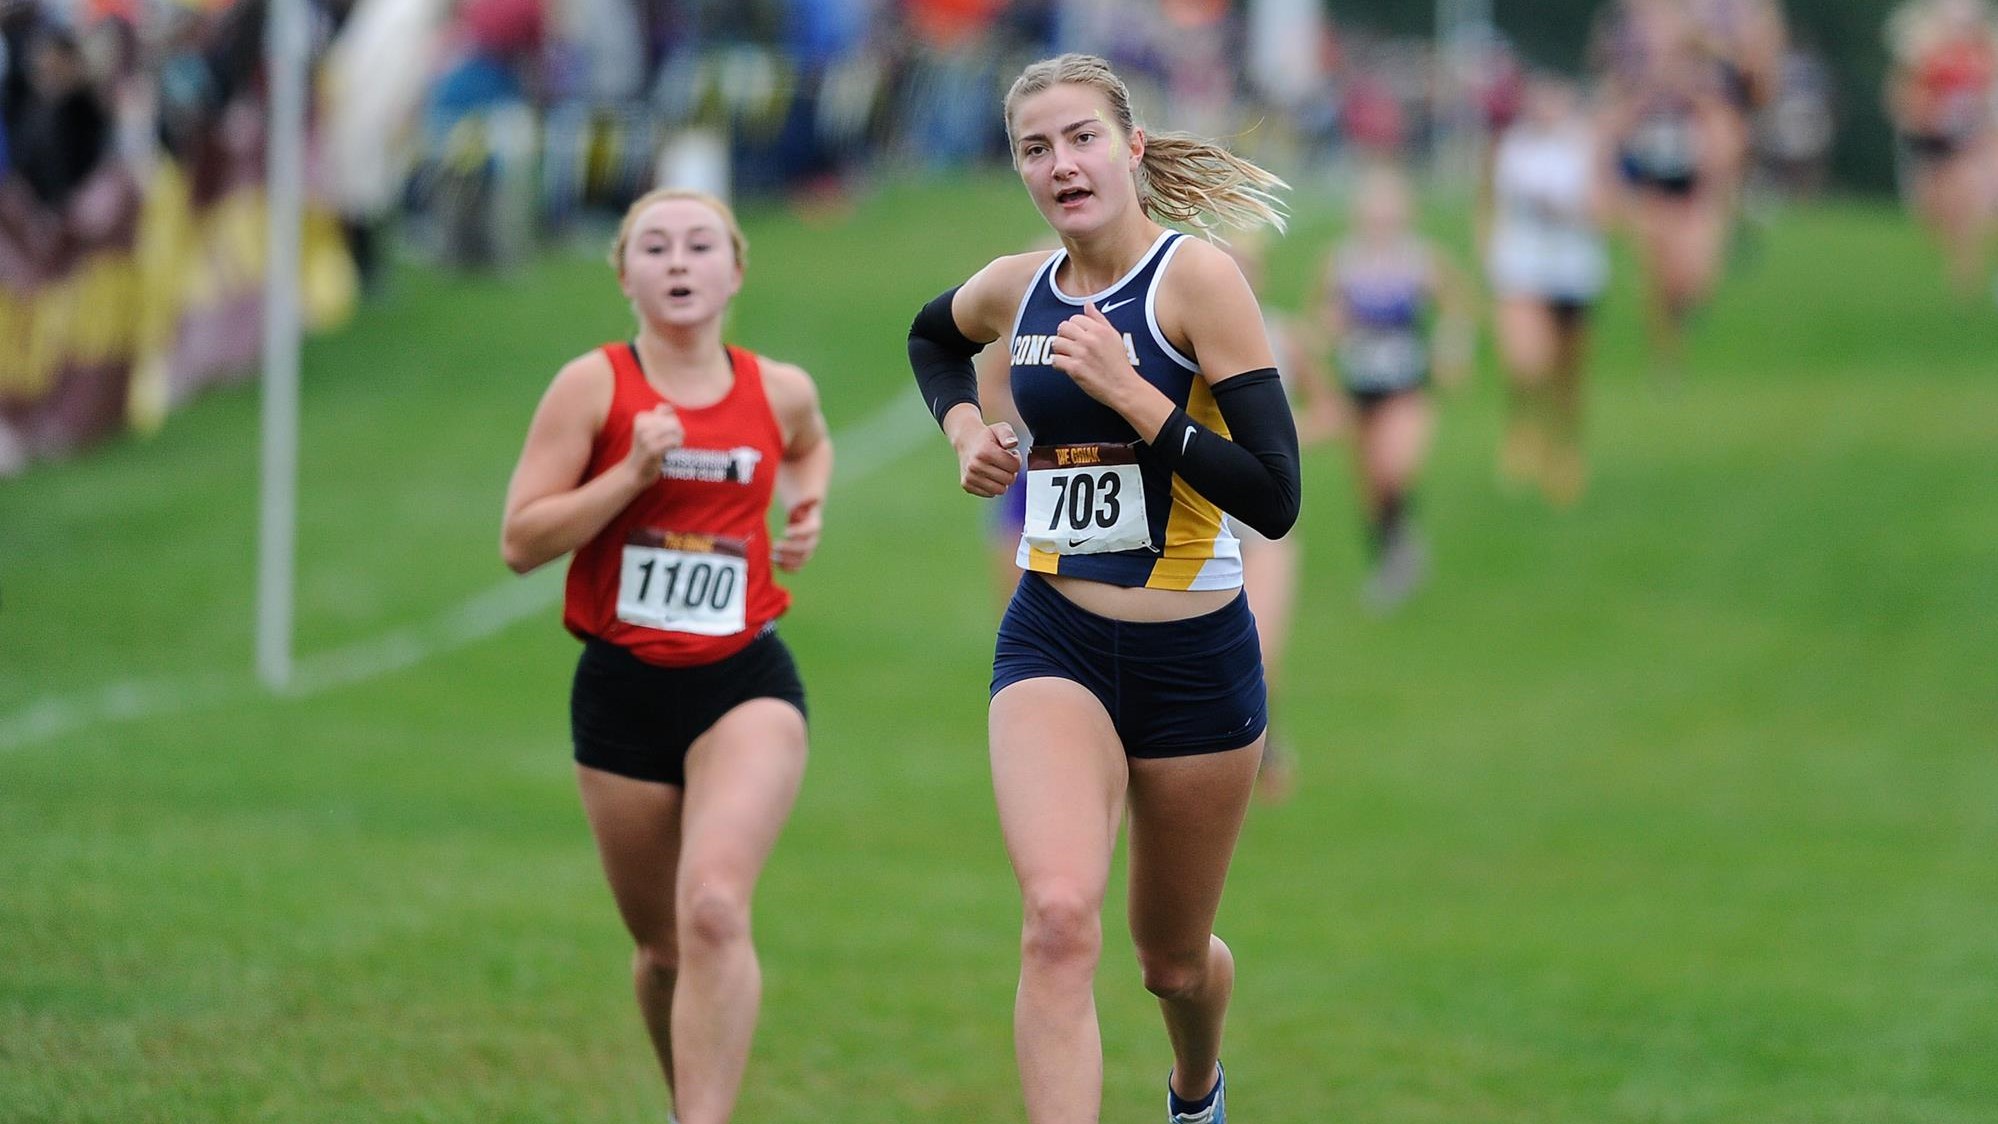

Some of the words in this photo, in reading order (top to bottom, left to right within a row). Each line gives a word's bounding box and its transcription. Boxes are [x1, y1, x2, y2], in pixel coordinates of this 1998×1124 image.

[1010, 332, 1140, 366] CONCA
[1048, 471, 1121, 531] 703
[637, 558, 735, 610] 1100
